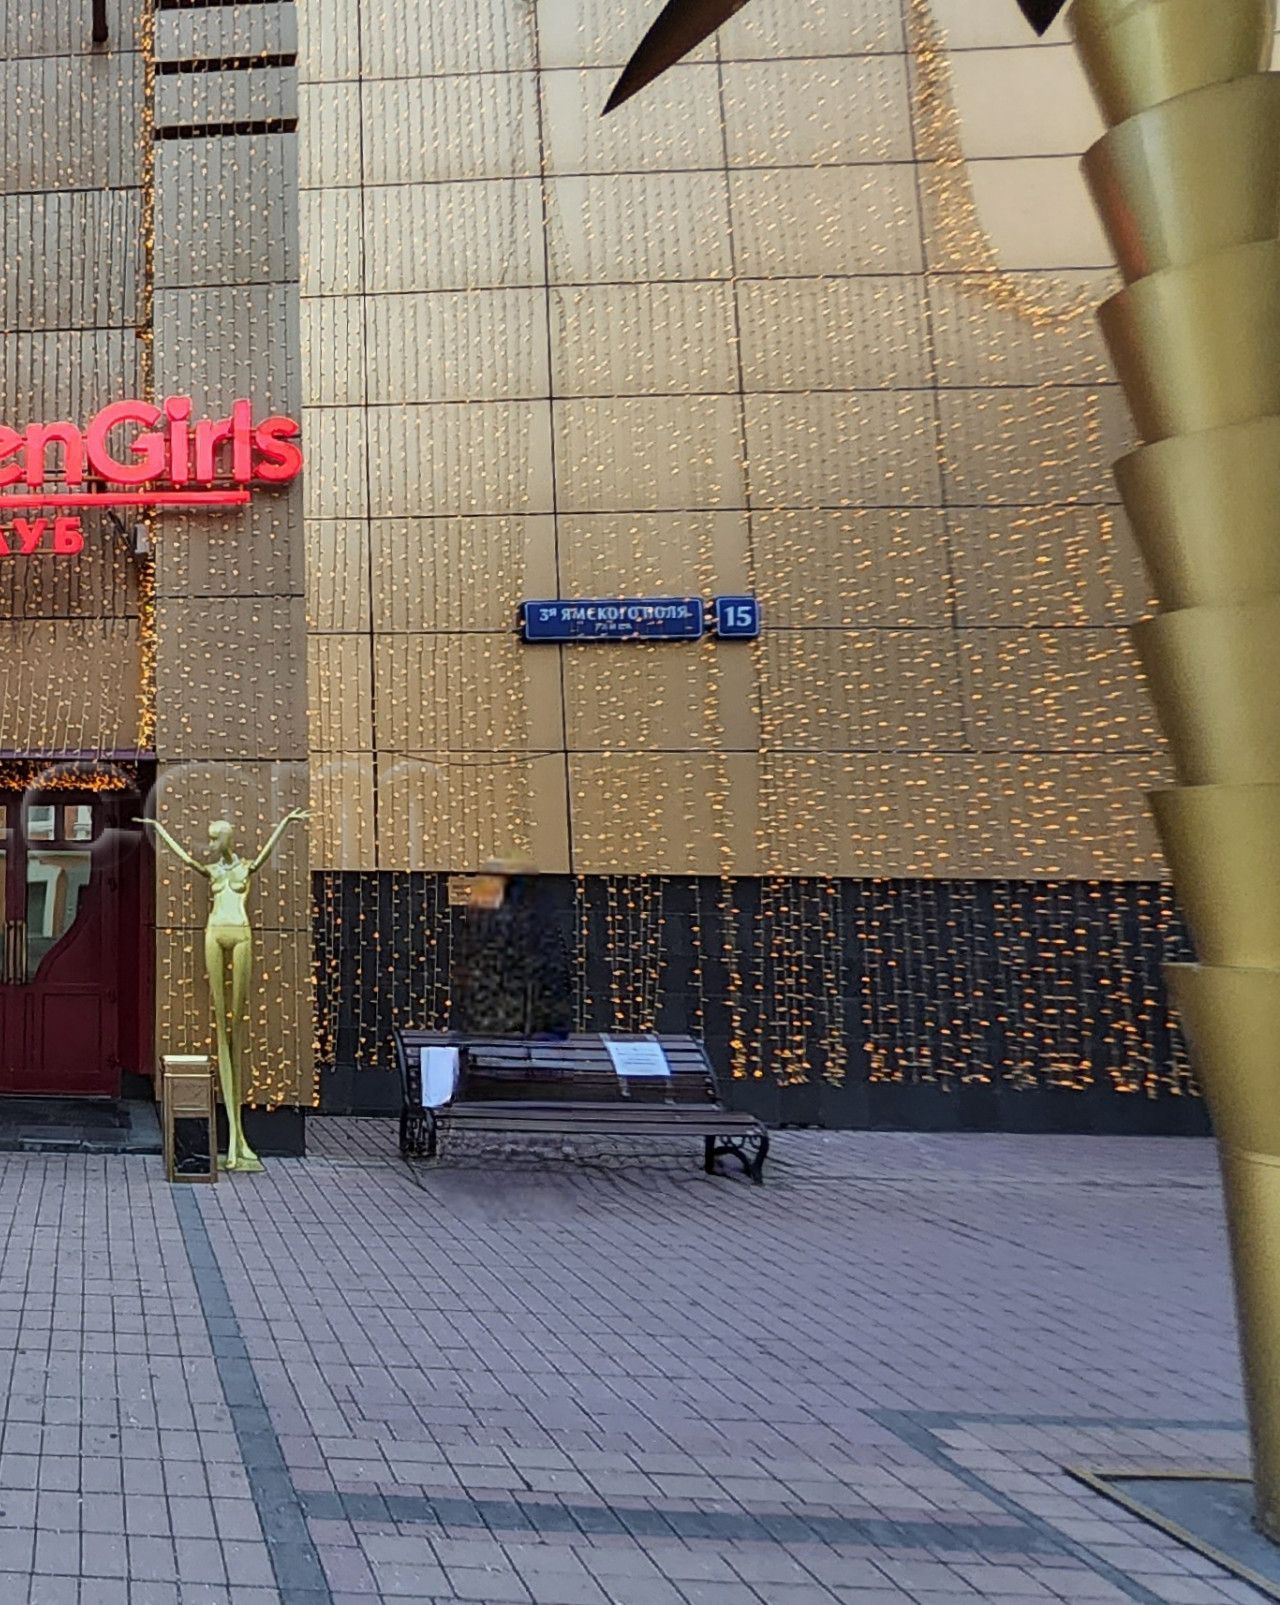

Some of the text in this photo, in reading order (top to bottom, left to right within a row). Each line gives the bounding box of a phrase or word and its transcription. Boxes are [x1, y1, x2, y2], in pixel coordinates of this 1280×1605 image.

[561, 606, 640, 620] ЯМСКОГО
[643, 606, 688, 619] ПОЛЯ
[723, 606, 752, 626] 15
